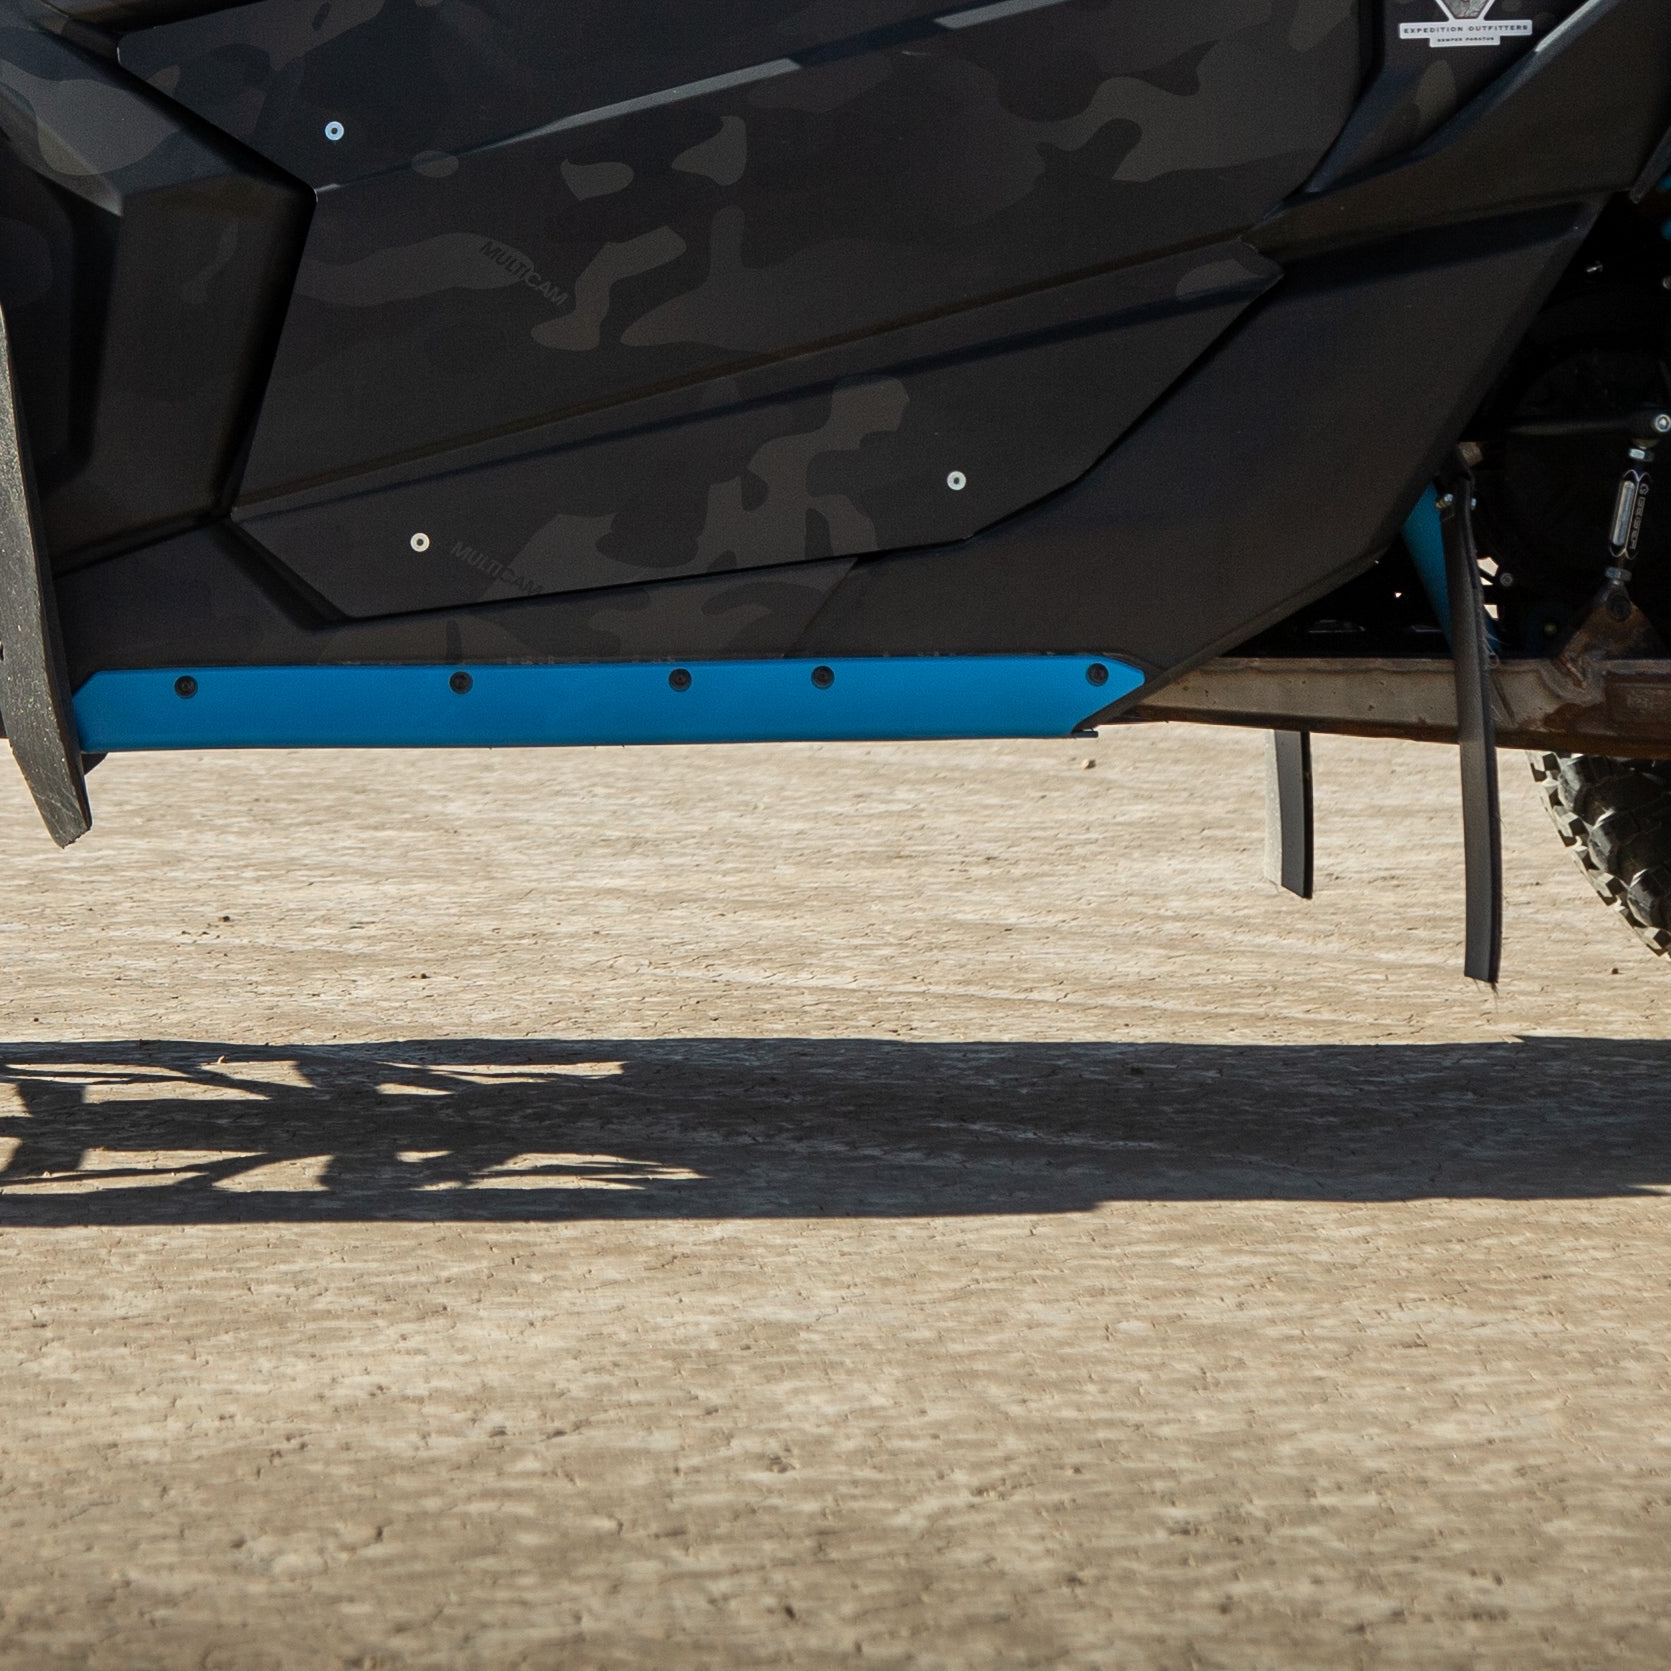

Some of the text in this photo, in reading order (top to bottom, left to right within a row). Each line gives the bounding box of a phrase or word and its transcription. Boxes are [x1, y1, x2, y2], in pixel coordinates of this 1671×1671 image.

[1404, 24, 1528, 34] EXPEDITION OUTFITTERS
[479, 241, 568, 306] MULTICAM
